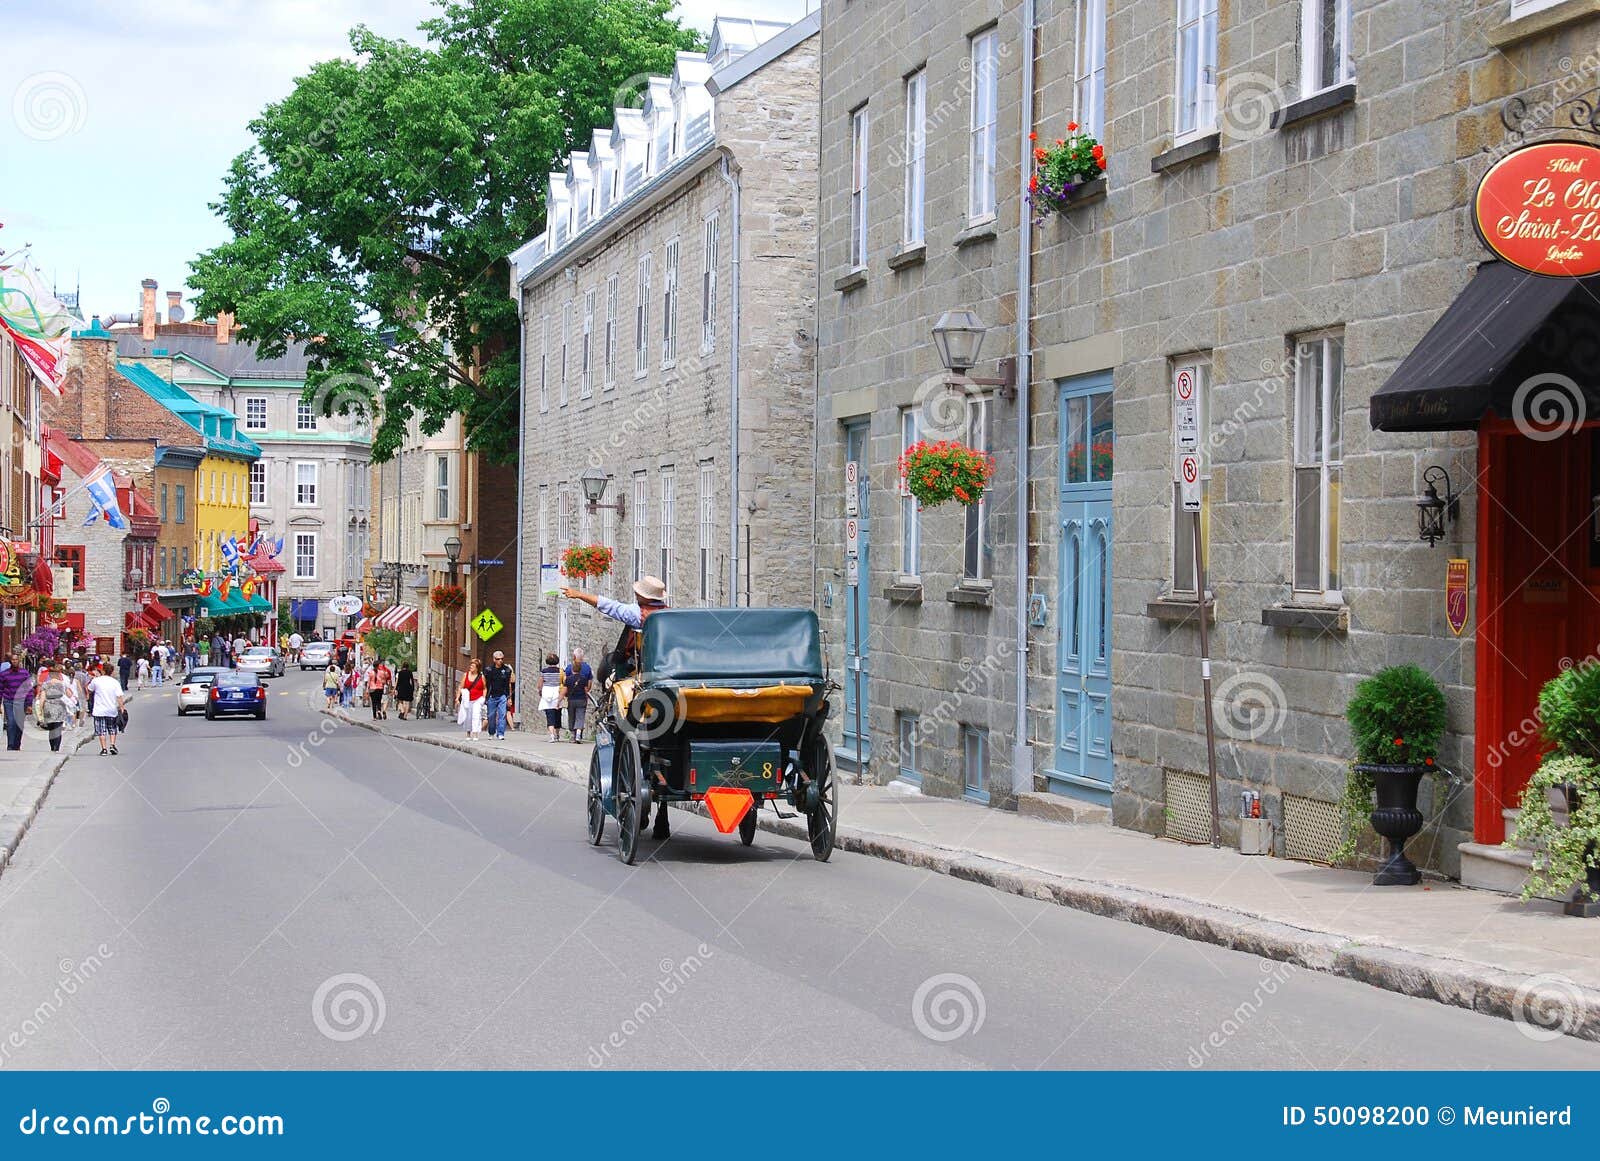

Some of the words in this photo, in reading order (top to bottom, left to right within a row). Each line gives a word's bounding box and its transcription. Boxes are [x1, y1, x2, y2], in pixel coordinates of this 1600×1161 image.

[1523, 177, 1556, 208] Le
[1563, 178, 1600, 210] Clo
[762, 762, 773, 779] 8
